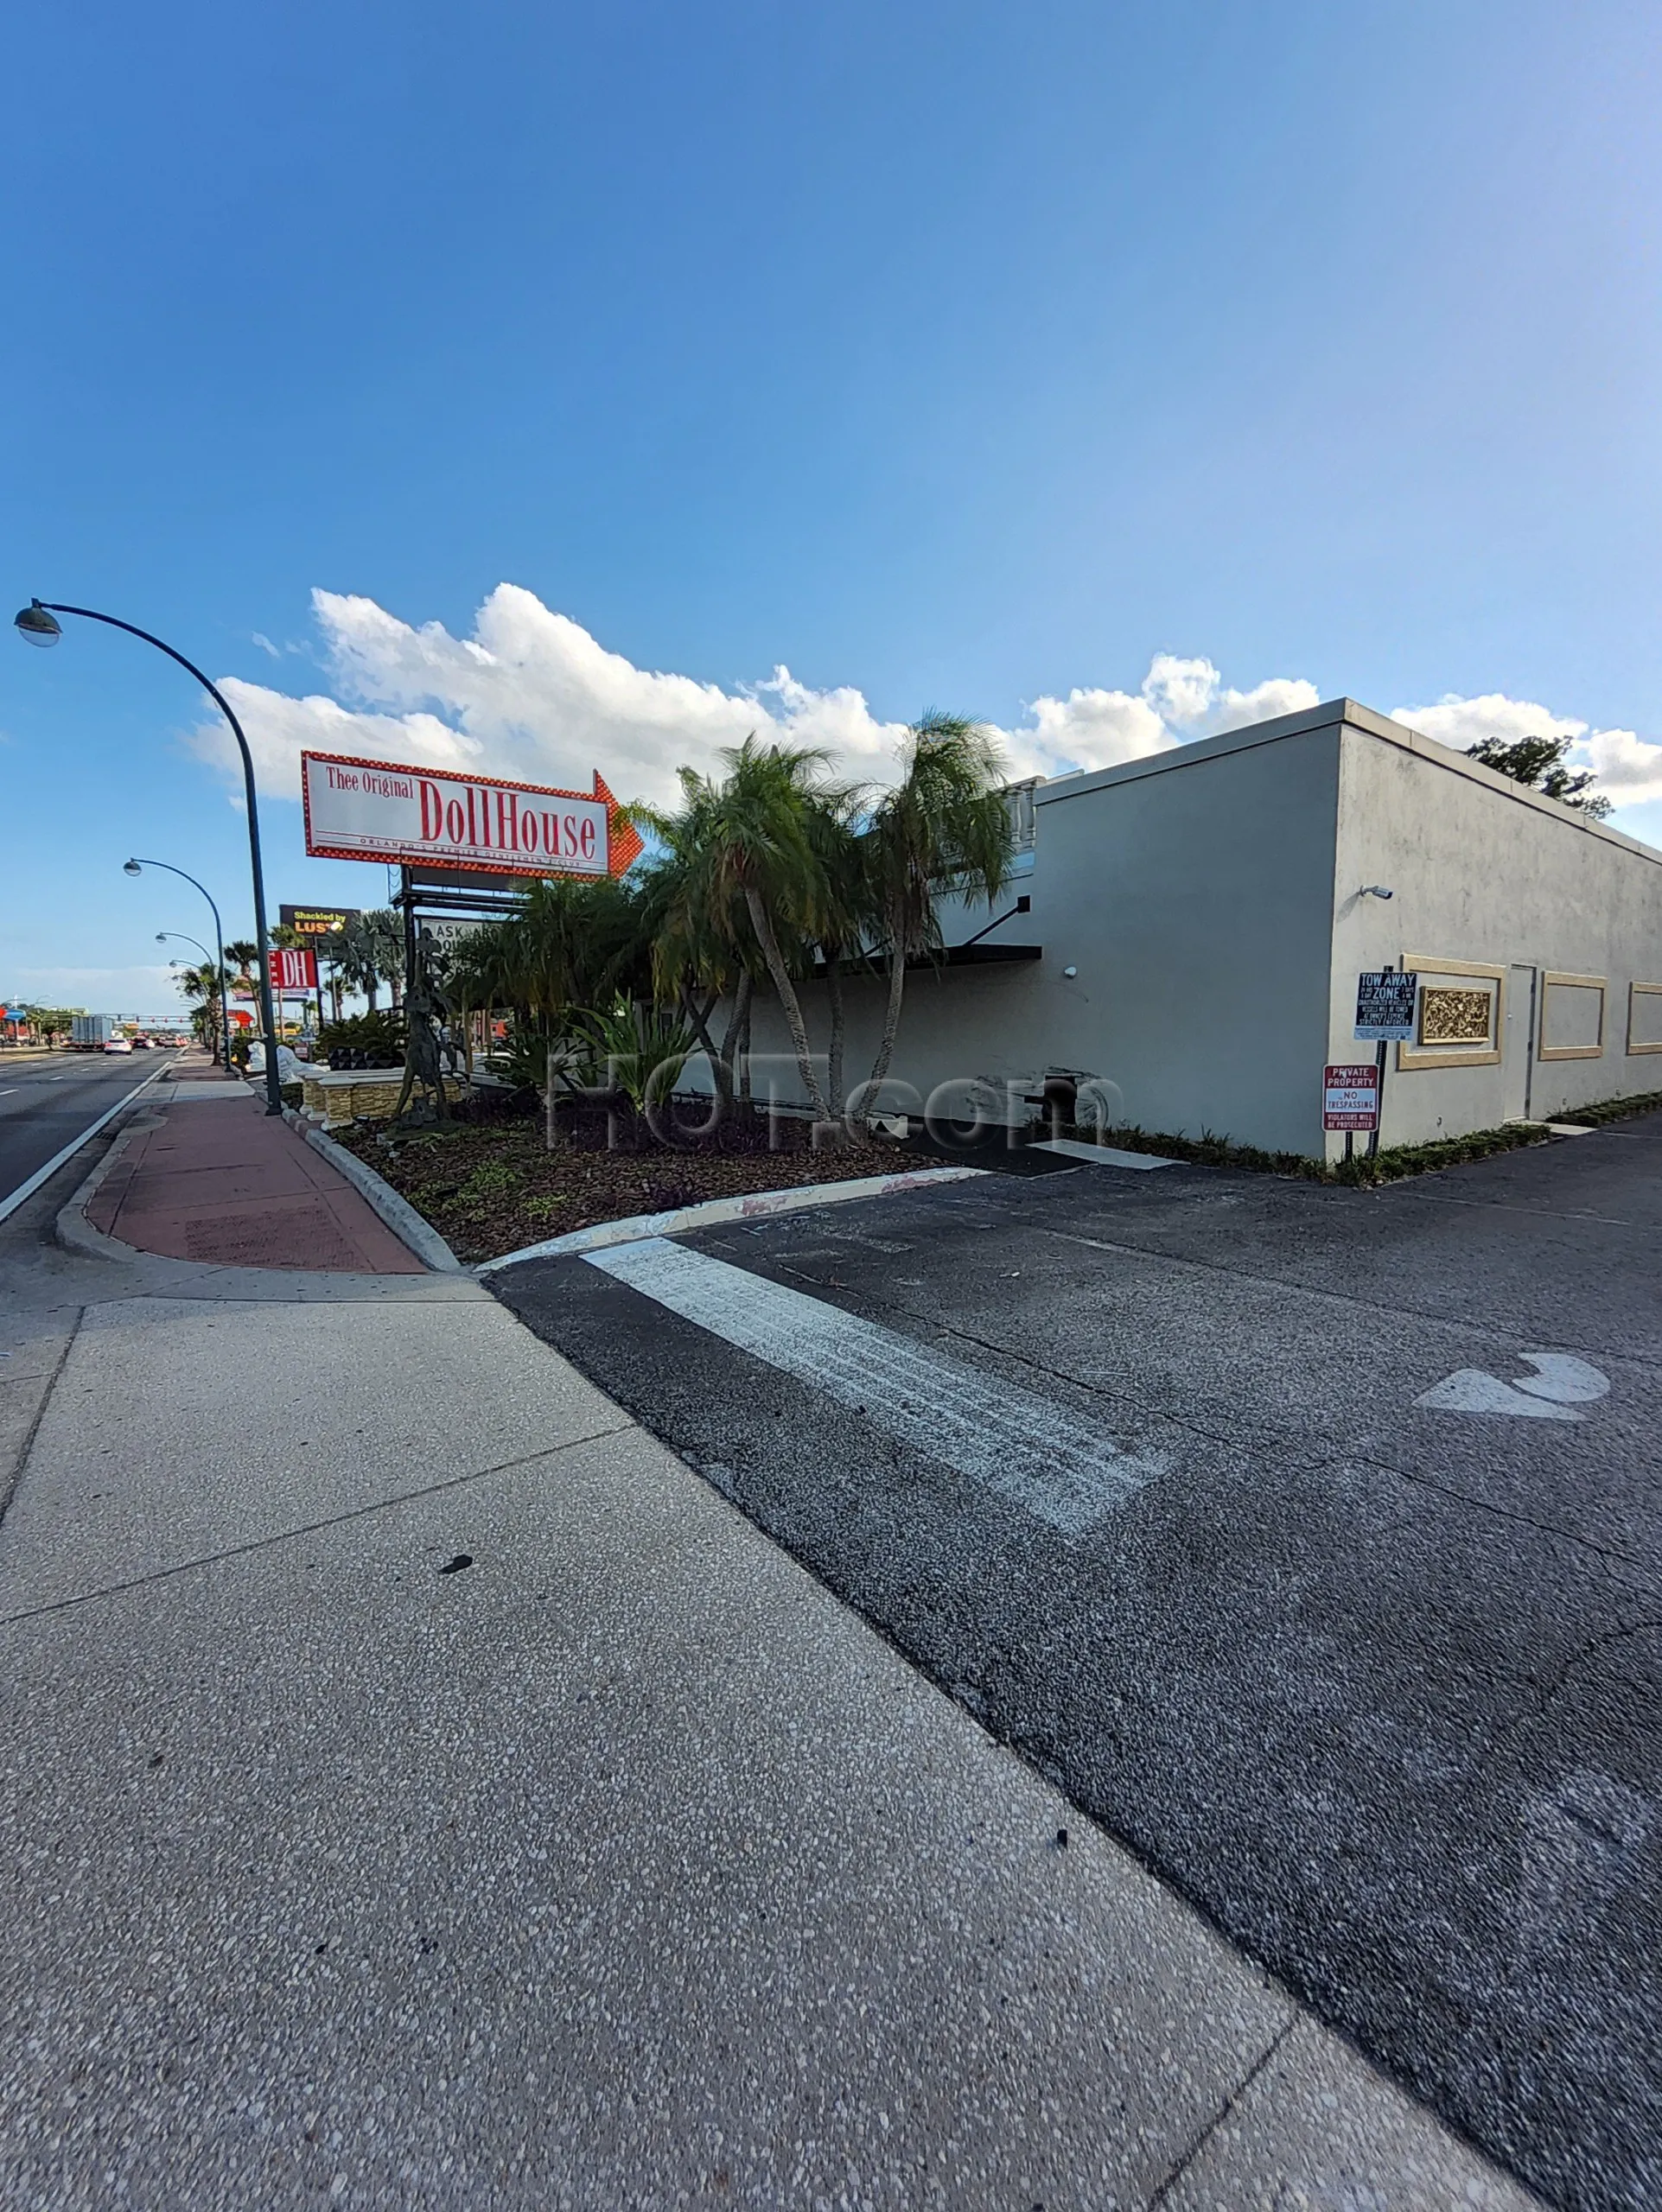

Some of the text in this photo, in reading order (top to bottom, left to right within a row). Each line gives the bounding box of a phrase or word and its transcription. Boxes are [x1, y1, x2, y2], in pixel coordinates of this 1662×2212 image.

[326, 766, 415, 798] Thee Original
[416, 779, 595, 860] DollHouse
[294, 912, 346, 923] Shackled by
[436, 925, 463, 938] ASK
[280, 950, 308, 987] DH
[1361, 974, 1415, 986] TOW AWAY
[1372, 987, 1401, 1000] ZONE
[1332, 1067, 1370, 1077] PRIVATE
[1327, 1077, 1374, 1087] PROPERTY
[1343, 1091, 1358, 1100] NO
